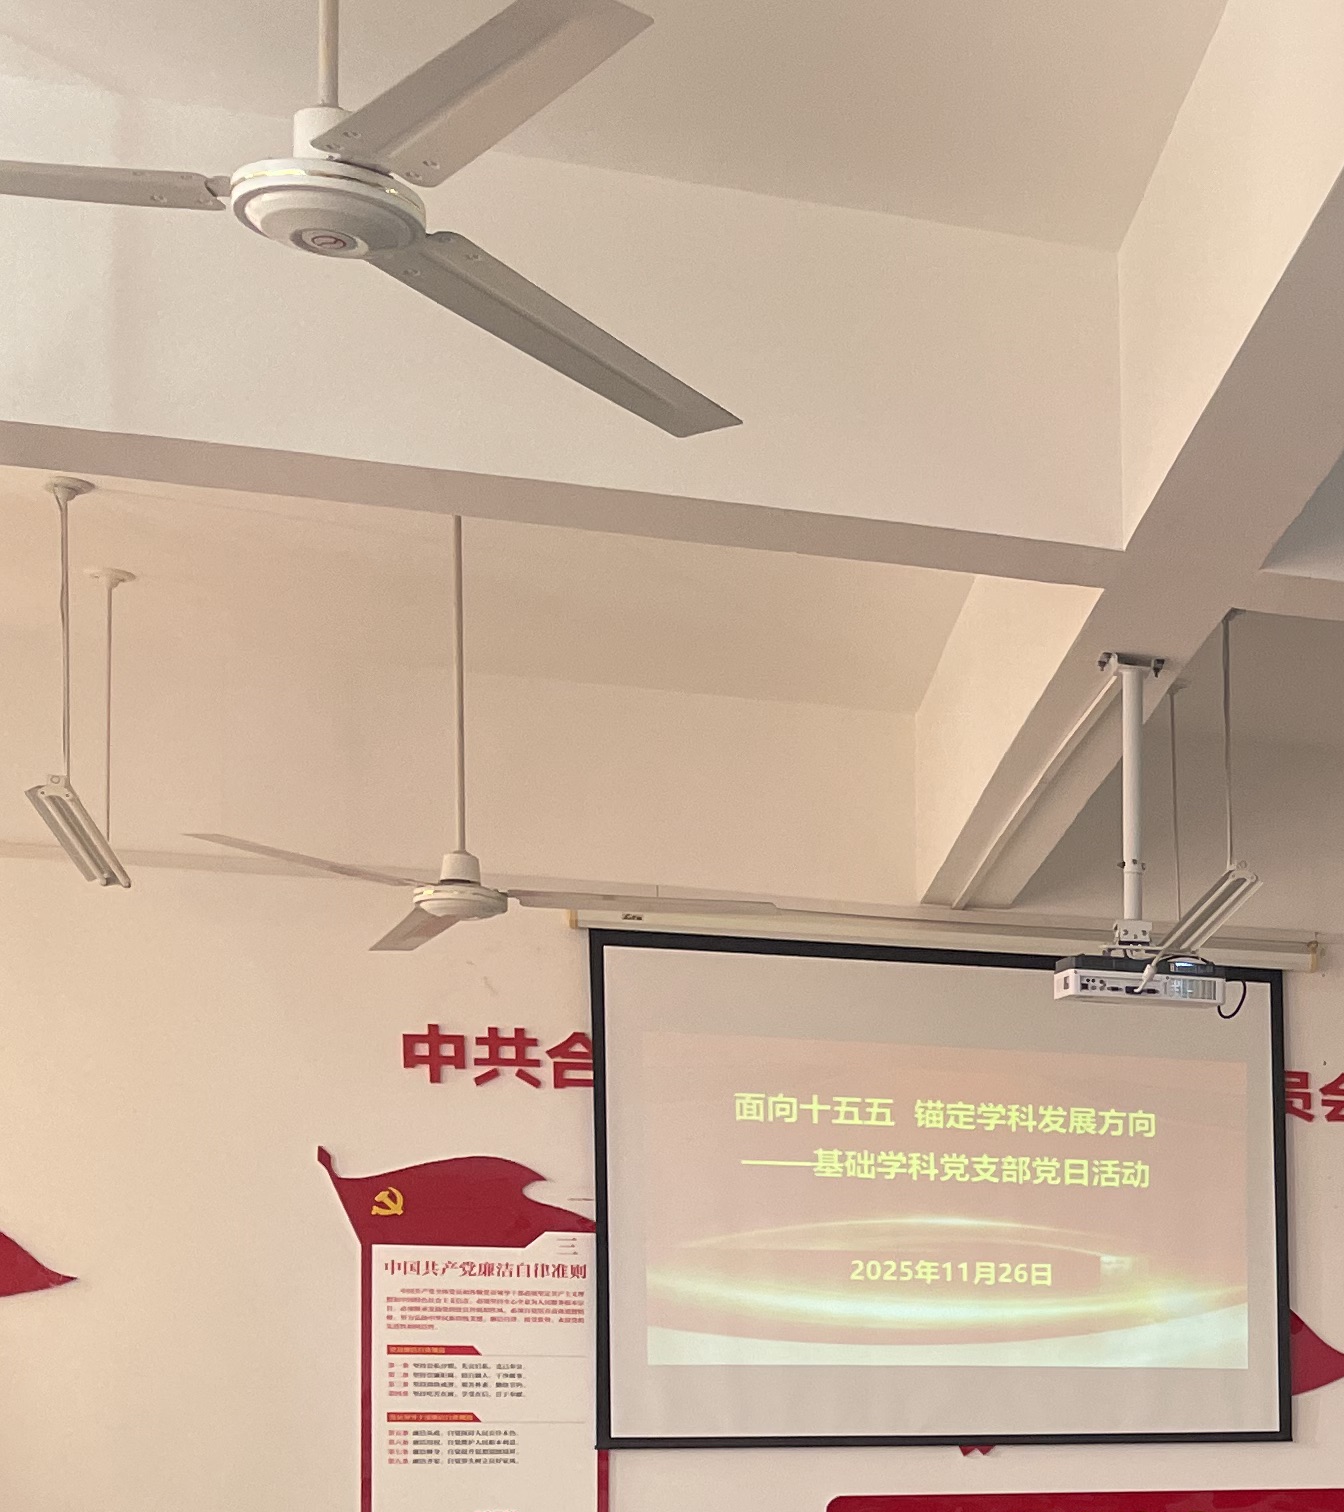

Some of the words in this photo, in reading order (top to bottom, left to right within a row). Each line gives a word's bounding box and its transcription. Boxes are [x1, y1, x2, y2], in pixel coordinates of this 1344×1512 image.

[402, 1023, 595, 1089] 中共合
[733, 1091, 896, 1128] 面向十五五
[913, 1099, 1157, 1138] 锚定学科发展方向
[741, 1149, 1151, 1189] ——基础学科党支部党日活动
[383, 1258, 587, 1280] 中国共产党廉洁自律准则
[849, 1257, 1053, 1288] 2025年11月26日
